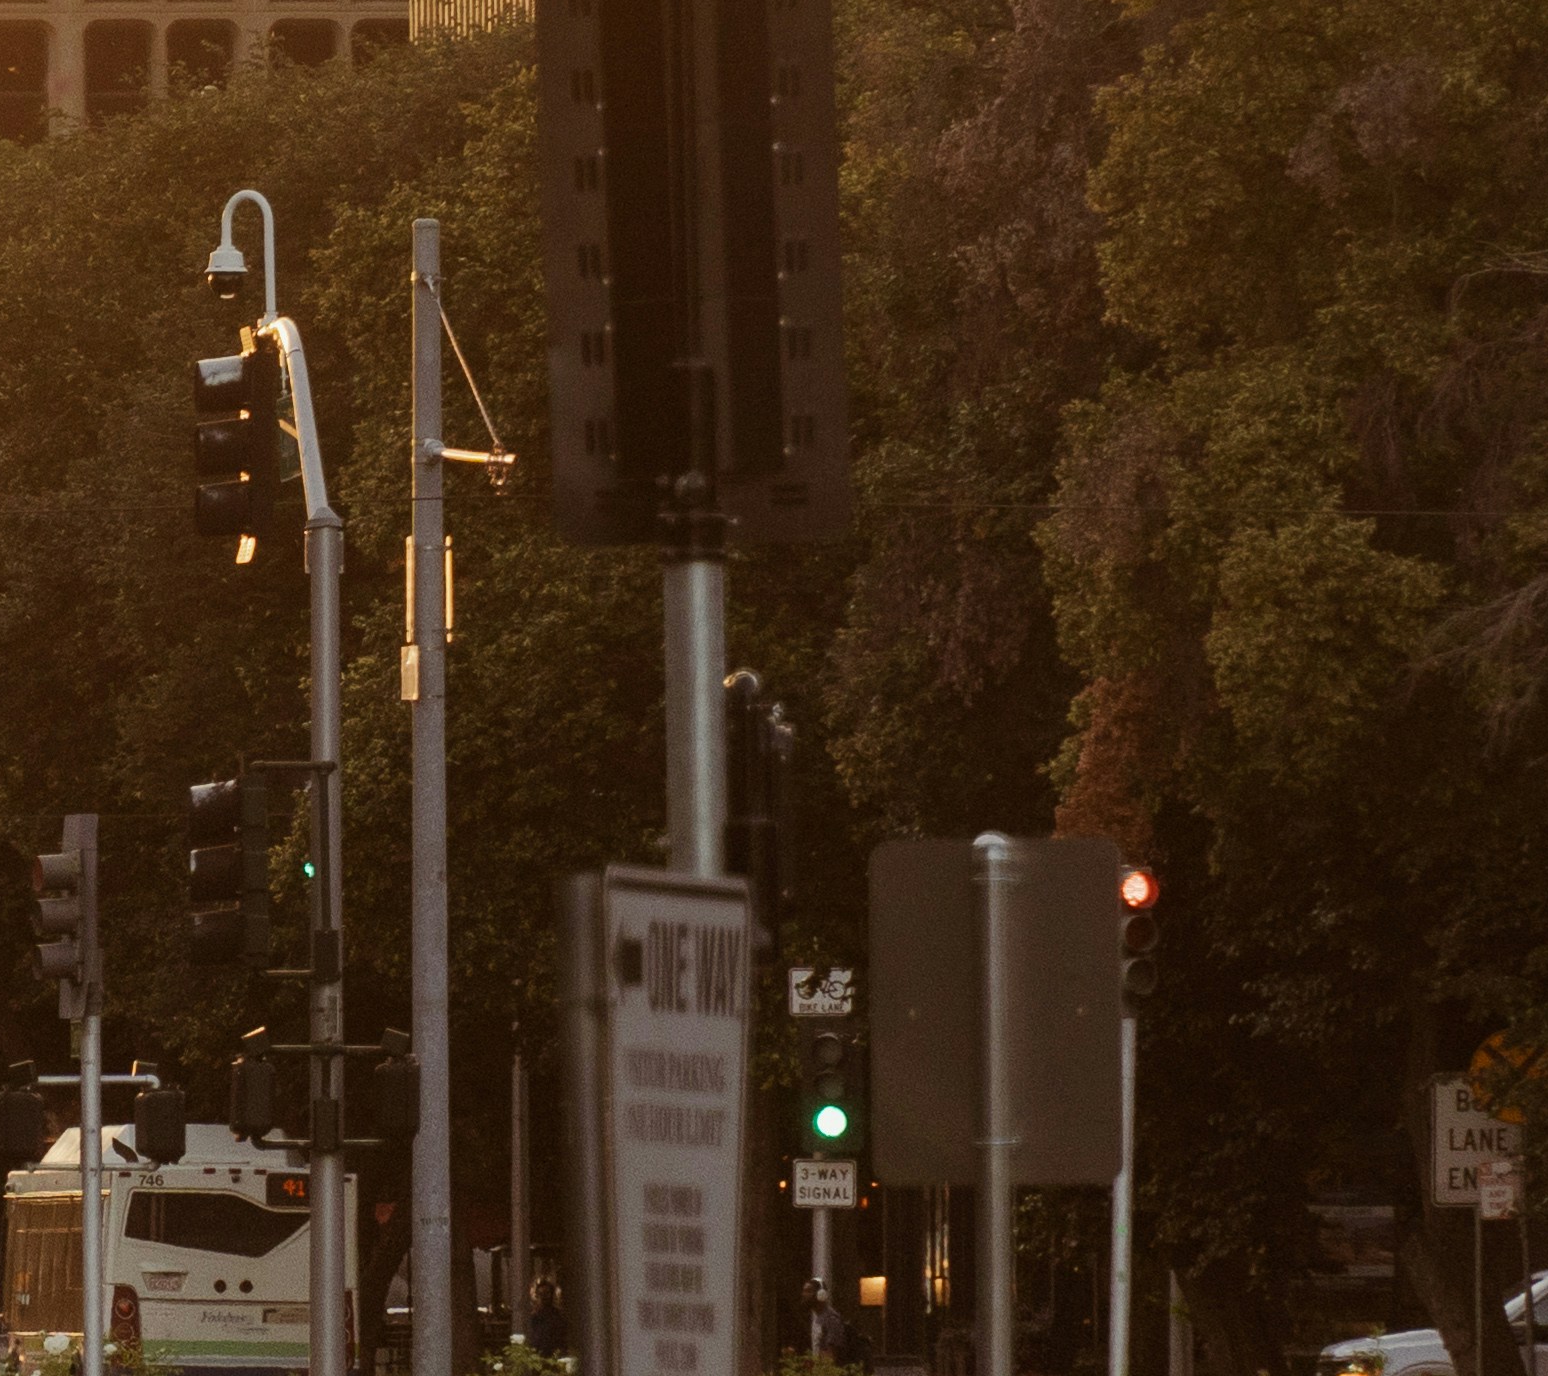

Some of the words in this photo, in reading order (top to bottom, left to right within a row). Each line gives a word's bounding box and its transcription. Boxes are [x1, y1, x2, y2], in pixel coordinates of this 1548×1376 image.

[649, 921, 687, 1013] ONE
[695, 924, 742, 1017] WAY
[1449, 1128, 1509, 1152] LANE
[139, 1174, 165, 1187] 746
[801, 1168, 849, 1181] 3-WAY
[1448, 1167, 1477, 1191] EN
[282, 1179, 306, 1198] 41
[798, 1186, 850, 1200] SIGNAL
